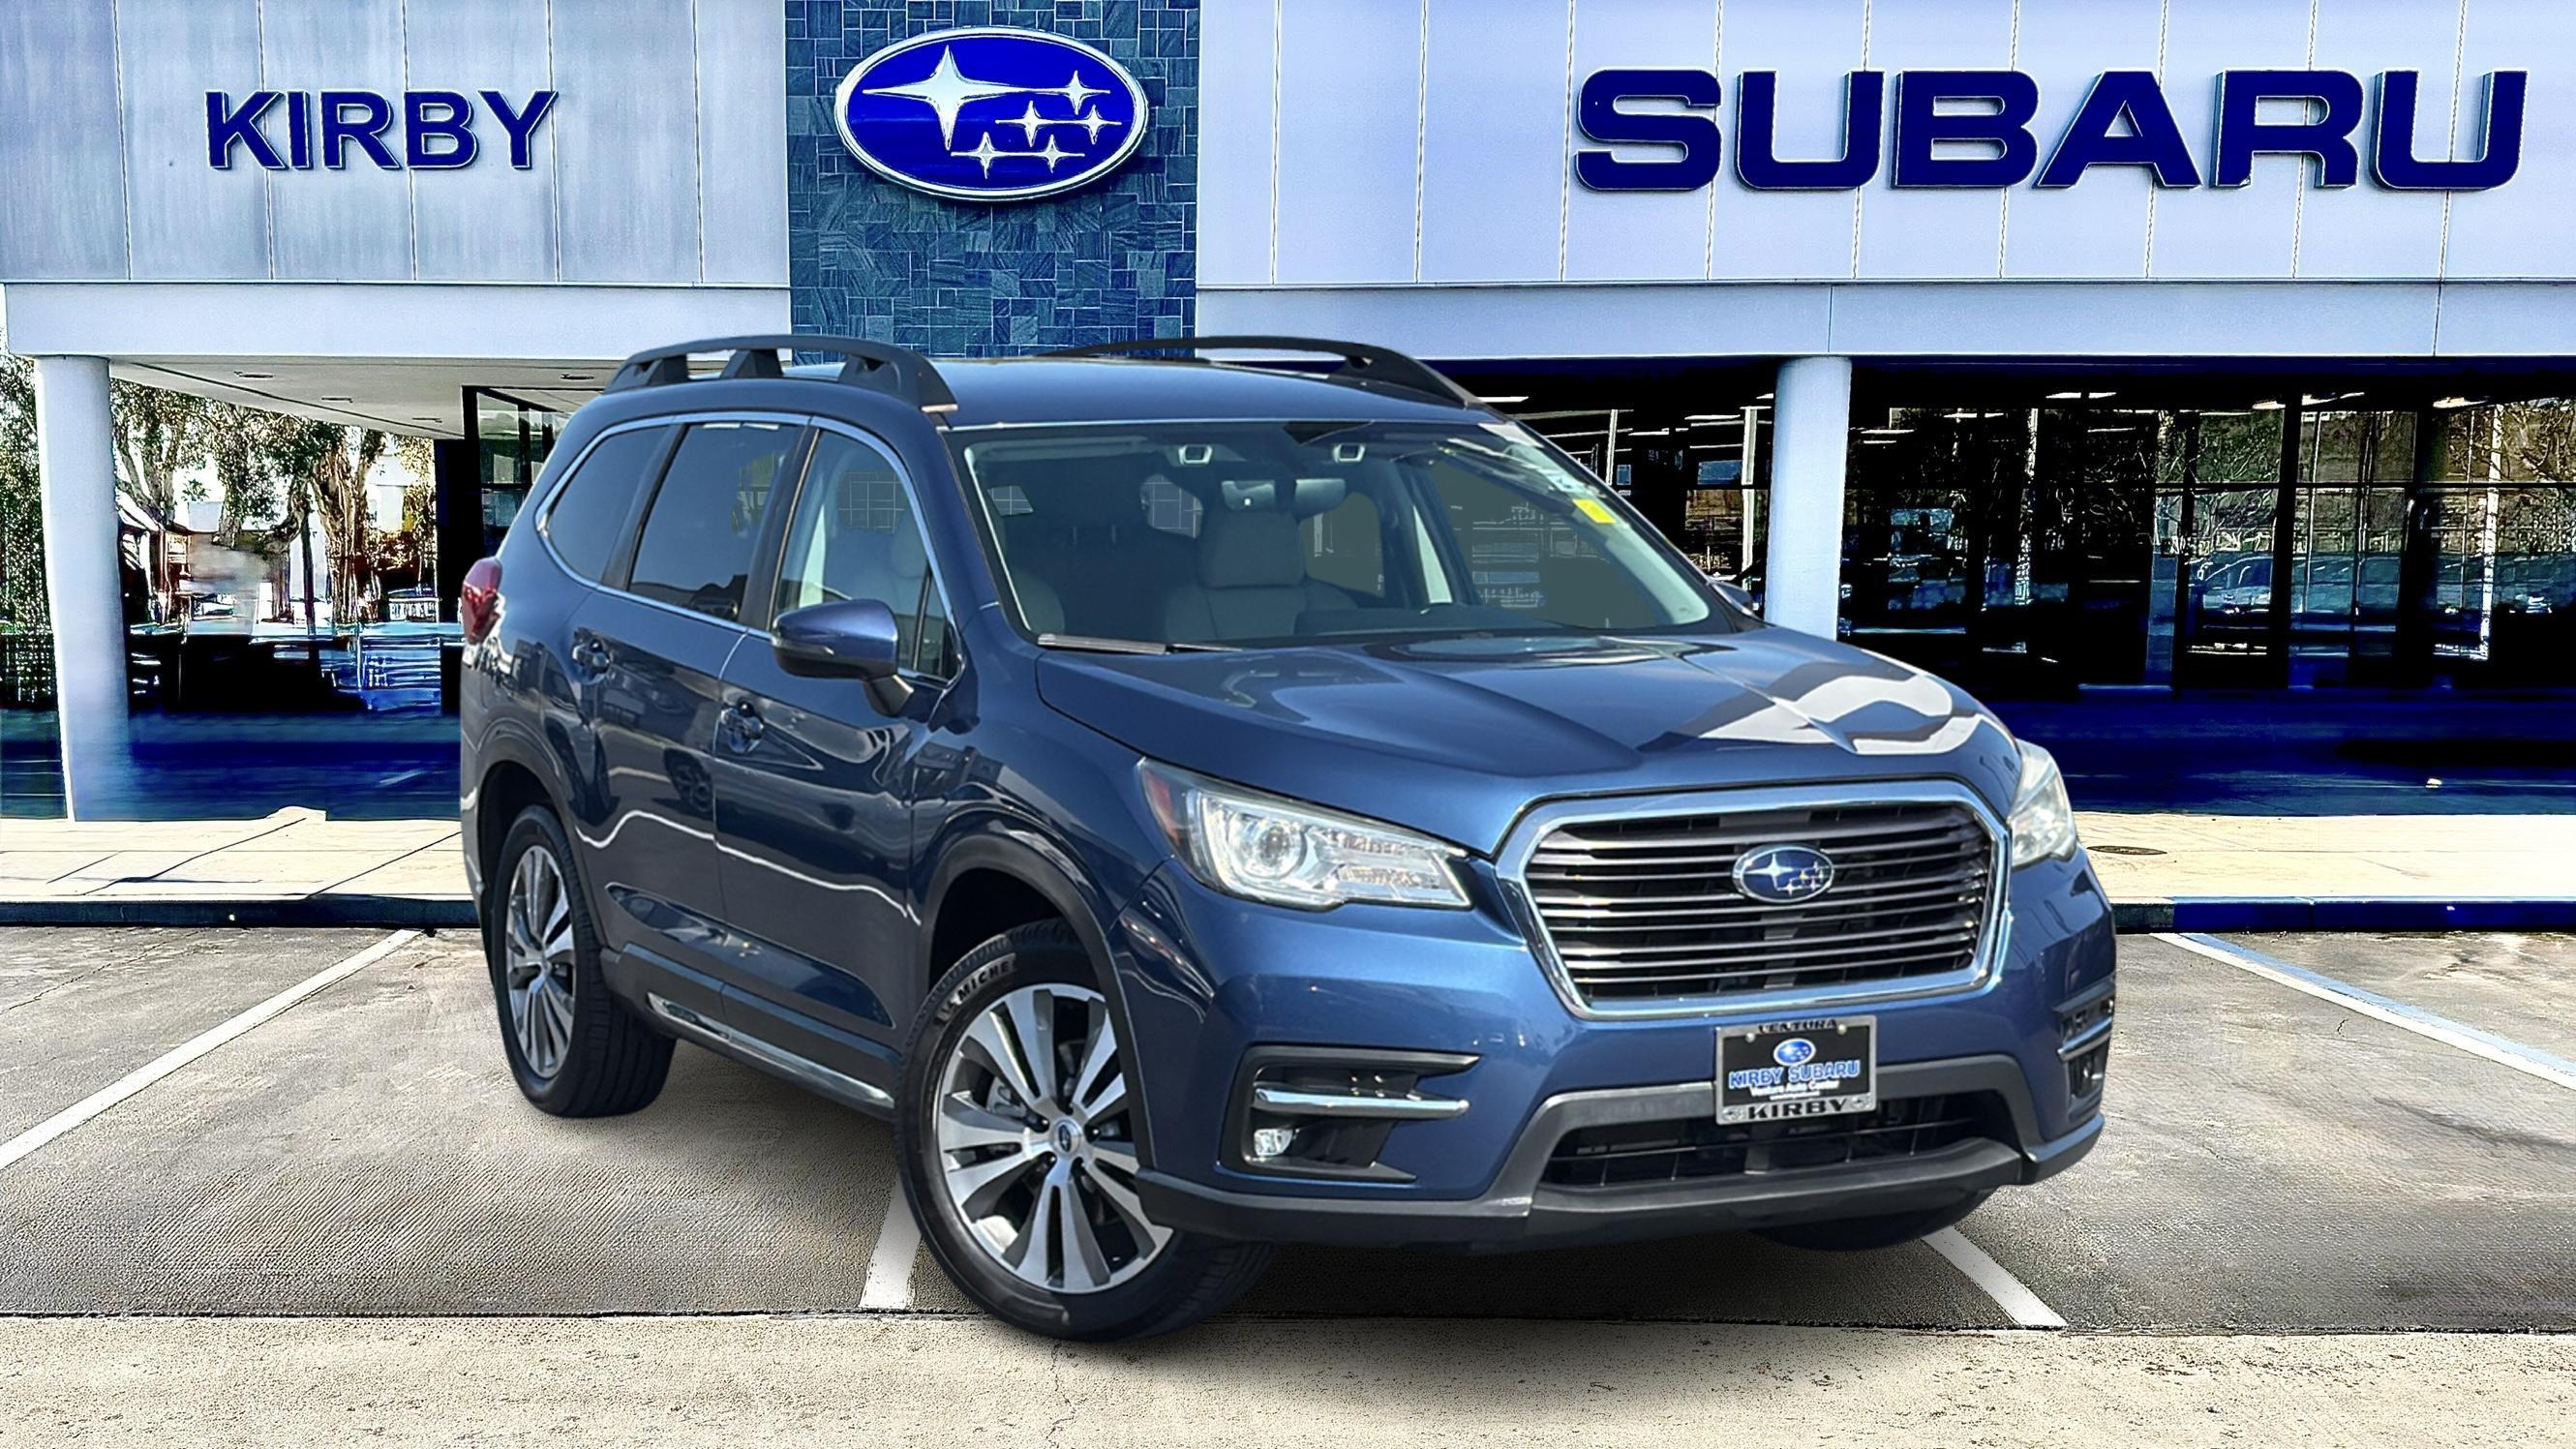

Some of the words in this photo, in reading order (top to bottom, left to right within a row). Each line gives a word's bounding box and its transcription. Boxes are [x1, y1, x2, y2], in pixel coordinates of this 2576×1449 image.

[204, 90, 560, 169] KIRBY
[1574, 68, 2527, 191] SUBARU
[1757, 1019, 1837, 1034] VENTURA
[1729, 1067, 1783, 1089] KIRBY
[1787, 1060, 1861, 1083] SUBARU
[1748, 1098, 1847, 1120] KIRBY
